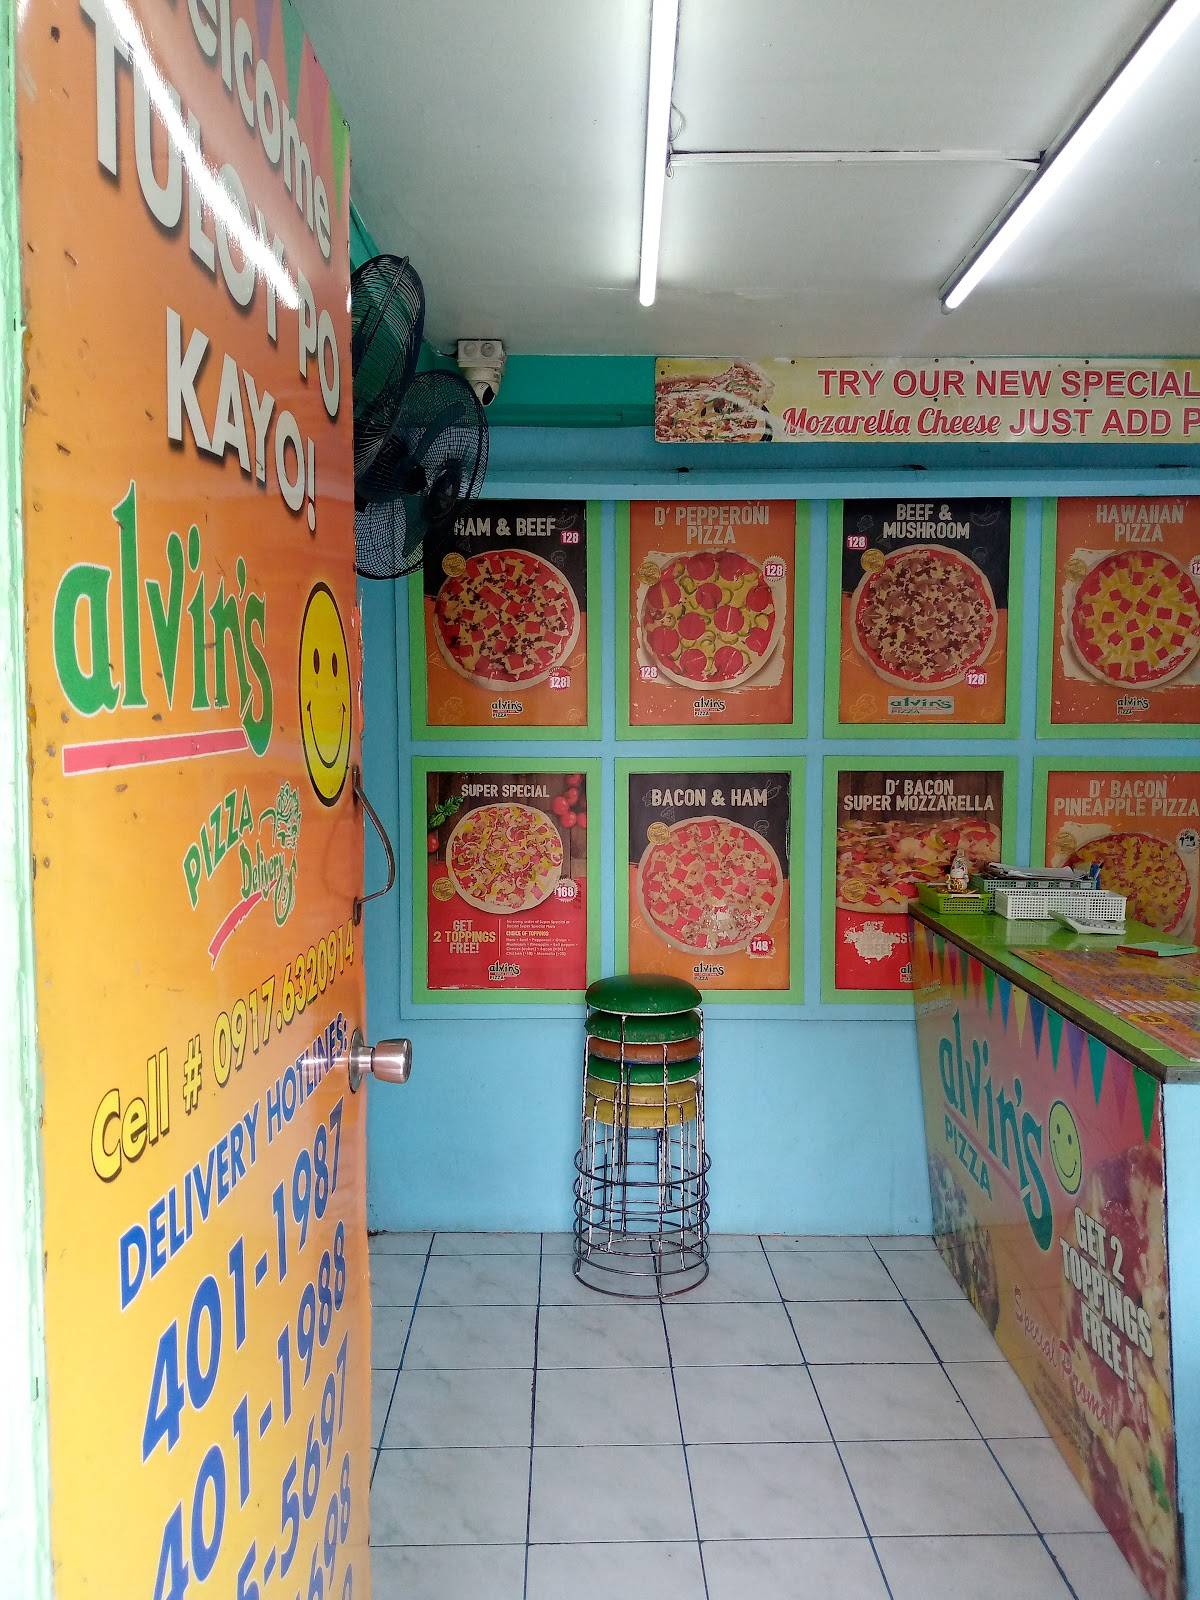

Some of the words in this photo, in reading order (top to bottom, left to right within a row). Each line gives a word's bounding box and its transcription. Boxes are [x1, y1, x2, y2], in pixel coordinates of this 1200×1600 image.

[187, 0, 332, 260] elcome
[817, 369, 883, 398] TRY
[892, 368, 966, 398] OUR
[975, 369, 1052, 398] NEW
[166, 305, 317, 532] KAYO!
[781, 405, 911, 437] Mozarella
[918, 406, 1002, 437] Cheese
[1008, 407, 1094, 436] JUST
[1102, 407, 1174, 436] ADD
[675, 505, 769, 526] PEPPERONI
[896, 503, 934, 521] BEEF
[938, 504, 953, 521] &
[1096, 504, 1184, 524] HAWAIIAN
[496, 517, 512, 536] &
[516, 517, 556, 536] BEEF
[686, 525, 737, 545] PIZZA
[882, 521, 970, 540] MUSHROOM
[1114, 523, 1164, 543] PIZZA
[561, 531, 579, 544] 128
[847, 536, 866, 548] 128
[765, 564, 784, 577] 128
[53, 480, 273, 757] alvin's
[640, 666, 658, 679] 128
[889, 696, 953, 710] alvin's
[461, 784, 499, 798] SUPER
[502, 784, 550, 798] SPECIAL
[651, 788, 706, 807] BACON
[711, 789, 726, 807] &
[731, 789, 768, 807] HAM
[885, 779, 900, 796] D'
[903, 779, 954, 796] BACON
[1110, 779, 1167, 799] BACON
[843, 795, 892, 811] SUPER
[895, 795, 994, 811] MOZZARELLA
[1053, 798, 1146, 817] PINEAPPLE
[1152, 798, 1200, 817] PIZZA
[183, 785, 253, 911] PIZZA
[452, 919, 474, 932] GET
[432, 931, 442, 943] 2
[444, 931, 497, 943] TOPPINGS
[751, 939, 770, 952] 148
[449, 942, 480, 954] FREE!
[90, 1047, 170, 1183] Cell
[182, 1034, 203, 1115] #
[212, 918, 356, 1087] 0917.6320914
[938, 1007, 1054, 1252] alvin's
[118, 1099, 261, 1311] DELIVERY
[266, 1011, 350, 1145] HOTLINES:
[944, 1113, 993, 1202] PIZZA
[1074, 1205, 1107, 1268] GET
[1110, 1235, 1125, 1283] 2
[141, 1097, 345, 1464] 401-1987
[1059, 1237, 1154, 1360] TOPPINGS
